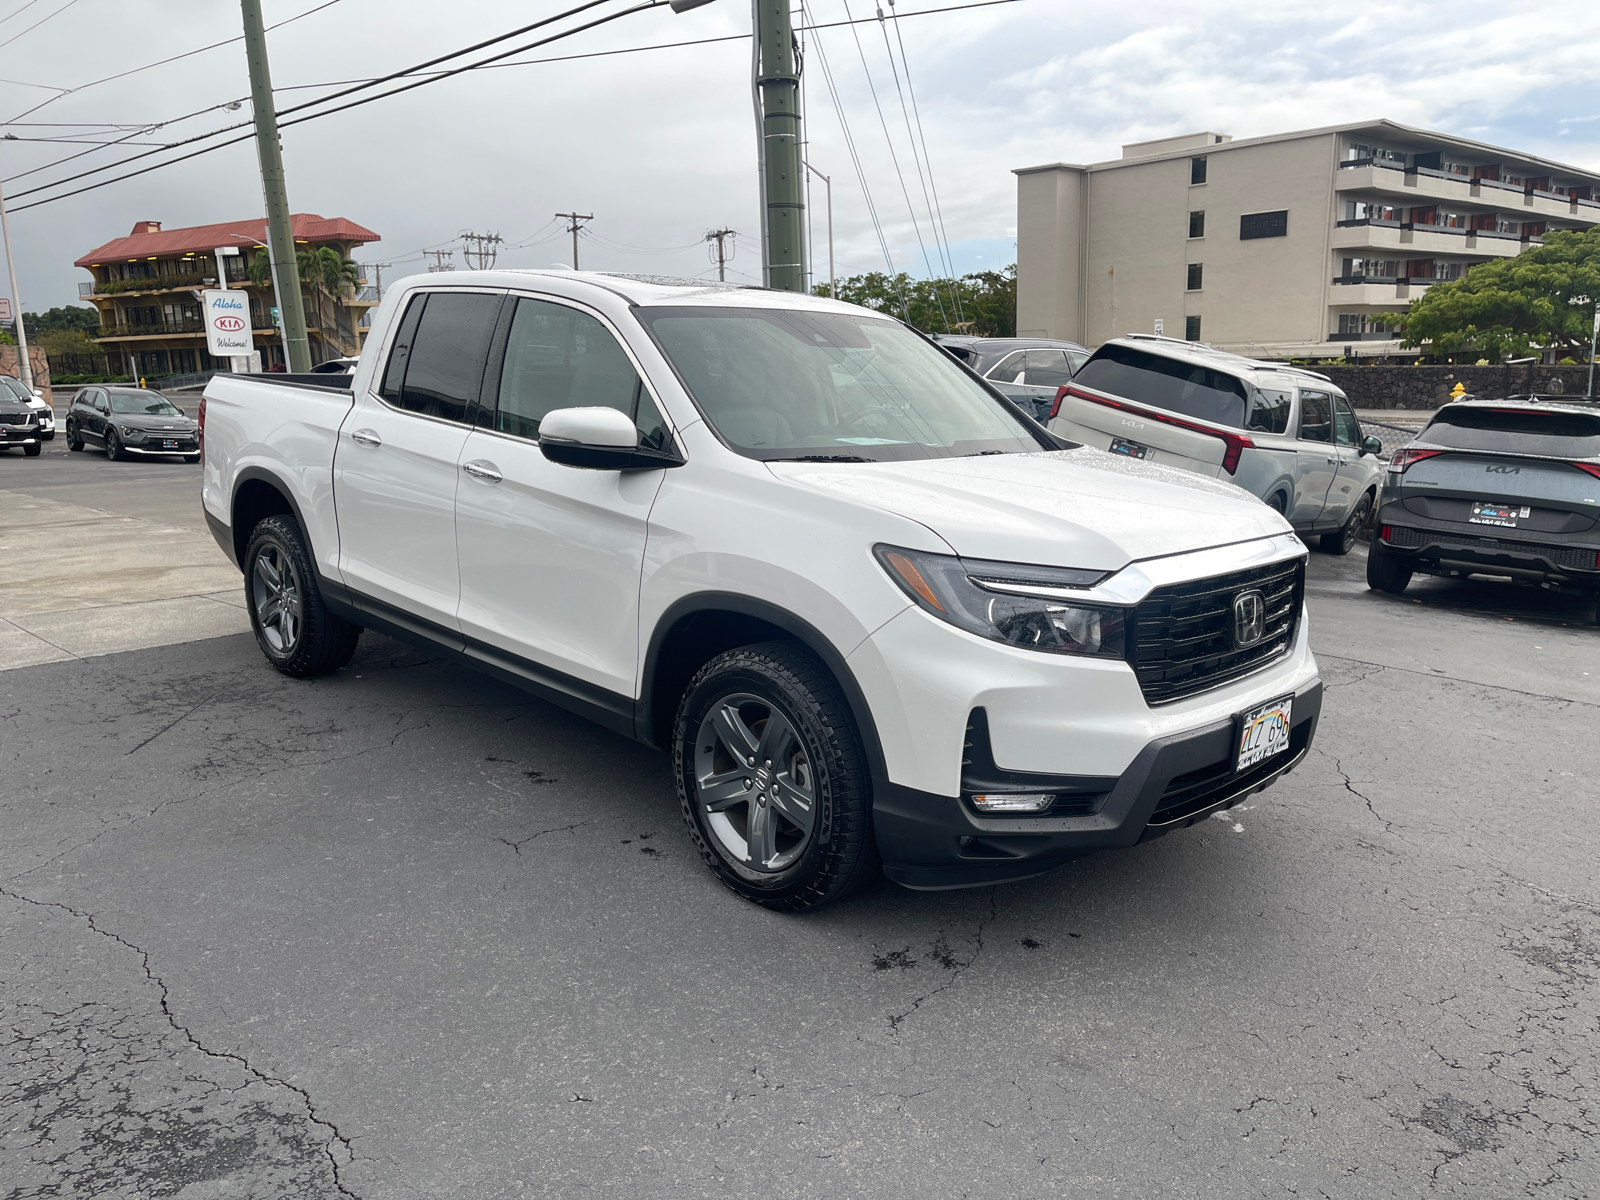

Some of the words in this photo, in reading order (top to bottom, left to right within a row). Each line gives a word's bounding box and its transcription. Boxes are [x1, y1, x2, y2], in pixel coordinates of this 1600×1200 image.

[212, 298, 243, 309] Aloha
[220, 319, 241, 328] KIA
[217, 338, 248, 348] Welcome!
[1121, 419, 1145, 430] KIA
[1485, 465, 1520, 475] KIA
[1268, 710, 1290, 743] 696
